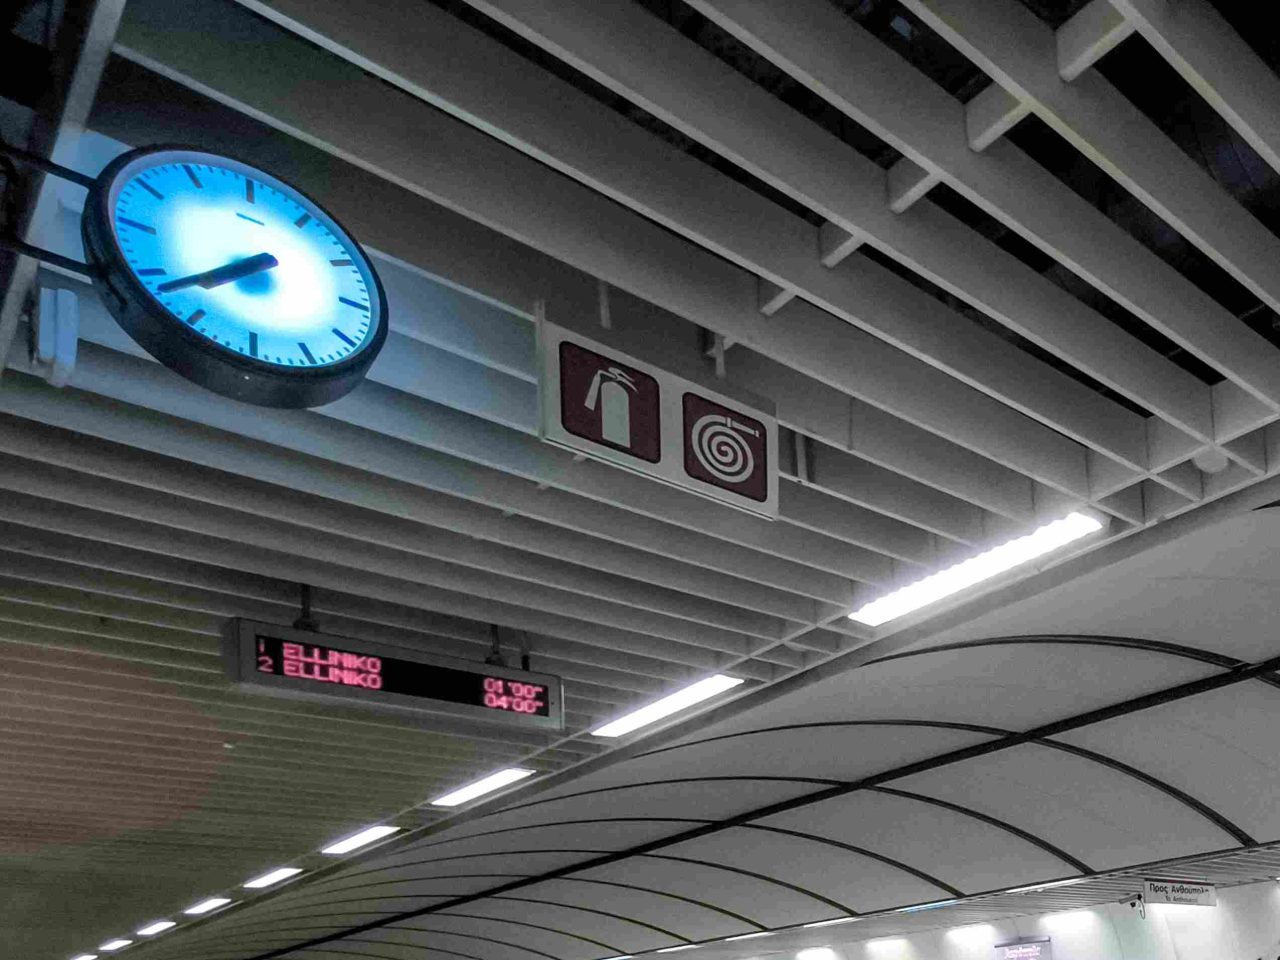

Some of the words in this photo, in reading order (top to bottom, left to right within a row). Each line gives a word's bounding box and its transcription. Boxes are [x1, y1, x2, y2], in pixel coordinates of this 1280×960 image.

[282, 642, 382, 672] ELLINIKO
[258, 656, 273, 672] 2
[282, 659, 382, 689] ELLINIKO
[1149, 883, 1168, 894] Προς
